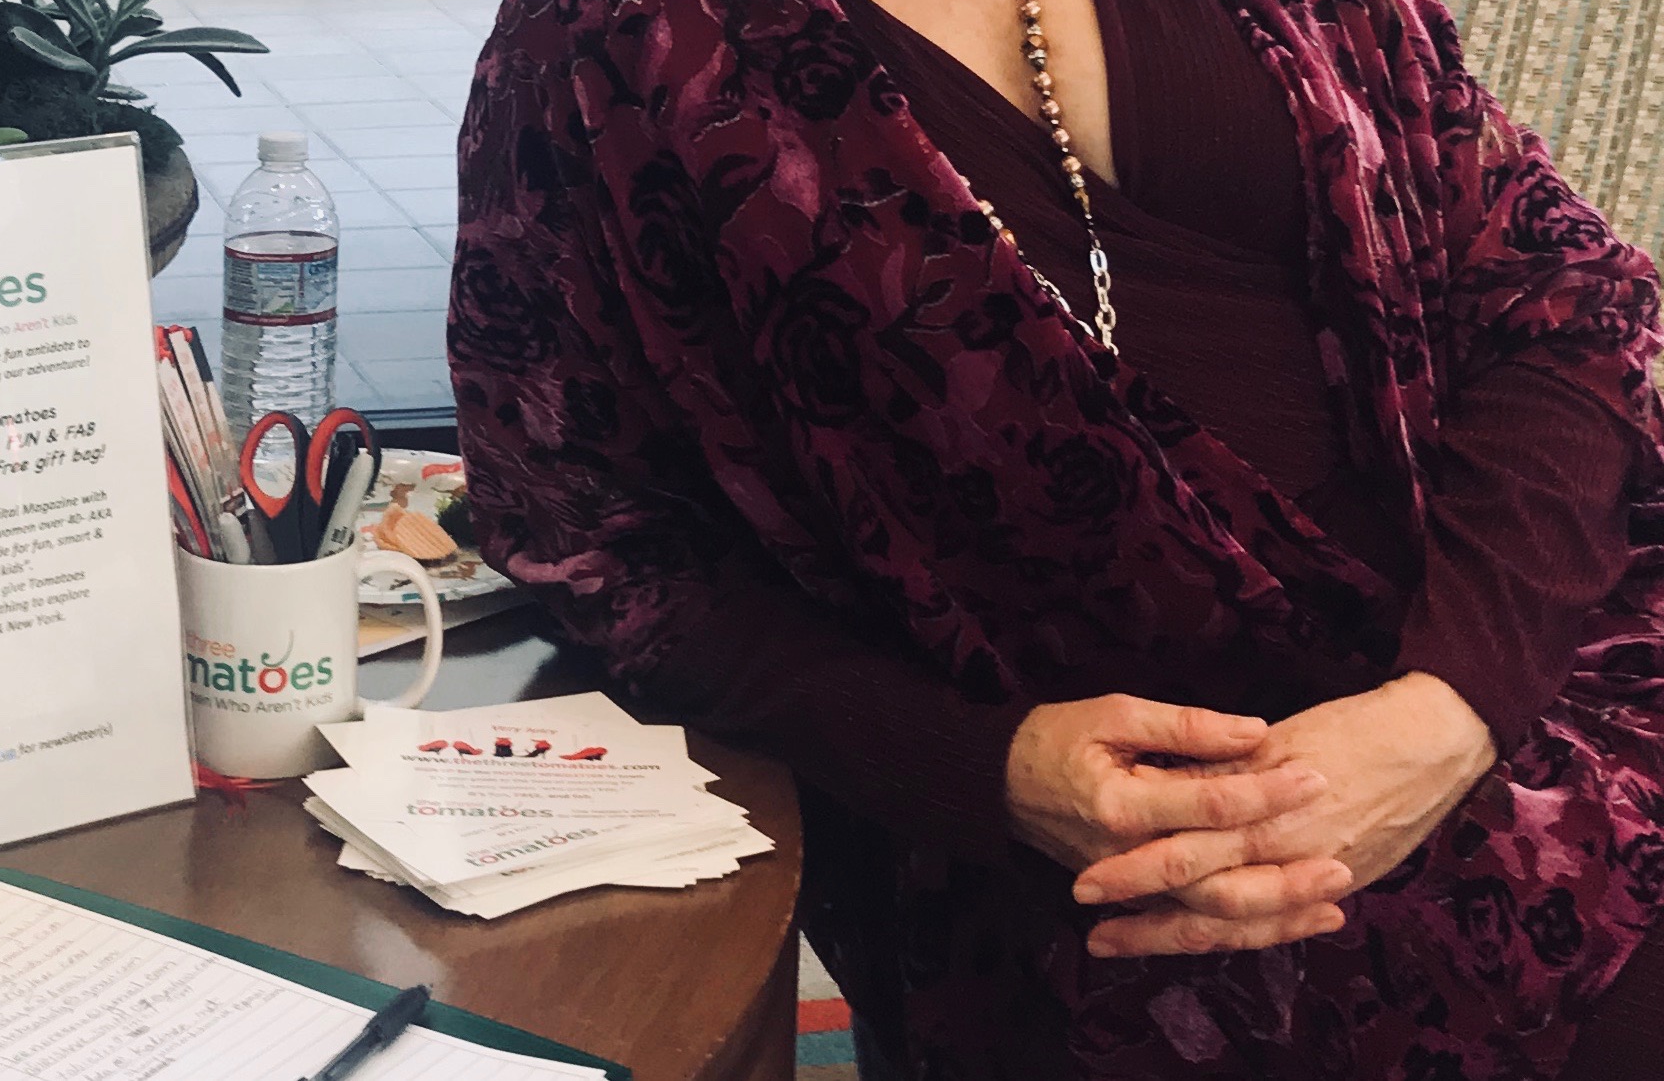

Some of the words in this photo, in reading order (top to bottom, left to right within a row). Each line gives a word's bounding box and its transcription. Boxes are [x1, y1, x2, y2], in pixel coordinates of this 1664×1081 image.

[13, 317, 49, 333] Aren't
[51, 314, 78, 326] Kids
[2, 348, 23, 362] fun
[25, 341, 75, 356] antidote
[77, 339, 90, 349] to
[3, 368, 25, 379] our
[26, 355, 89, 375] adventure!
[46, 428, 57, 443] &
[66, 421, 95, 436] FAB
[34, 450, 65, 474] gift
[72, 444, 105, 464] bag!
[22, 496, 79, 514] Magazine
[81, 490, 107, 504] with
[38, 518, 66, 530] over
[11, 542, 30, 557] for
[57, 530, 90, 546] smart
[93, 528, 102, 539] &
[0, 582, 26, 597] give
[28, 570, 85, 588] Tomatoes
[31, 597, 44, 608] to
[46, 588, 90, 605] explore
[7, 620, 32, 631] New
[17, 743, 36, 758] for
[406, 804, 553, 818] tomatoes
[465, 827, 598, 867] tomatoes
